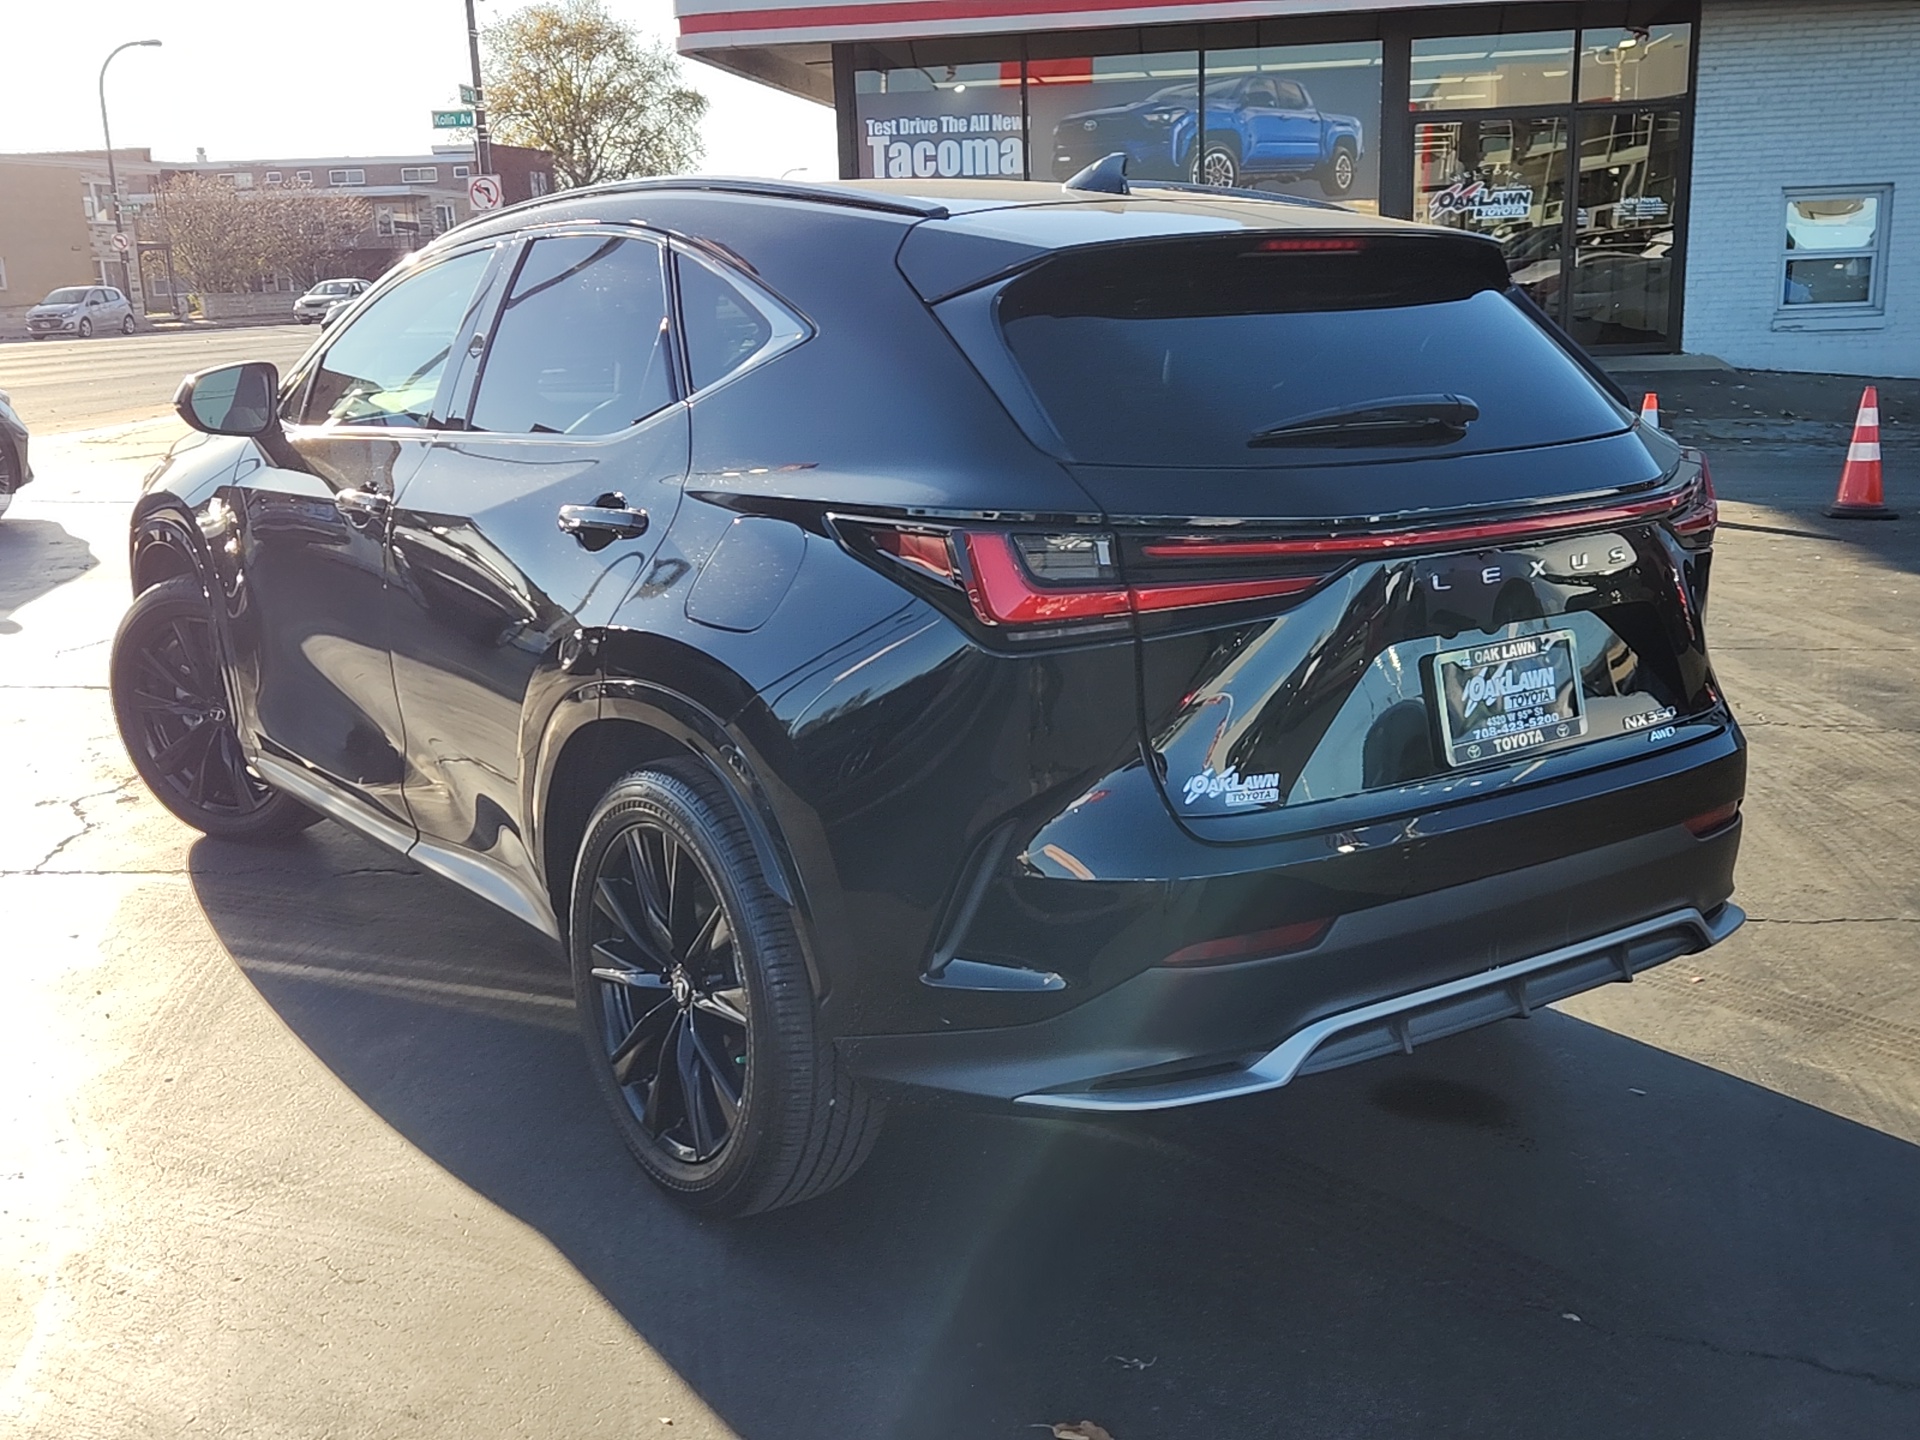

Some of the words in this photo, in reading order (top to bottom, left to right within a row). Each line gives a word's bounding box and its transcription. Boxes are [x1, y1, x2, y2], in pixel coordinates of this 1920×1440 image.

[434, 114, 456, 126] Kolin
[460, 114, 472, 125] Av
[866, 119, 897, 136] Test
[899, 117, 938, 134] Drive
[940, 115, 967, 133] The
[969, 114, 990, 132] All
[992, 113, 1030, 131] New
[867, 136, 1031, 178] Tacoma
[1450, 168, 1522, 182] WELCOME
[1481, 206, 1525, 217] TOYOTA
[1432, 546, 1626, 590] LEXUS
[1474, 646, 1501, 662] OAK
[1502, 640, 1537, 658] LAWN
[1510, 690, 1551, 708] TOYOTA
[1508, 713, 1517, 721] W
[1533, 707, 1544, 716] St
[1473, 712, 1560, 740] 708-423-5200
[1649, 726, 1676, 742] AWD
[1493, 730, 1544, 752] TOYOTA
[1232, 790, 1272, 802] TOYOTA
